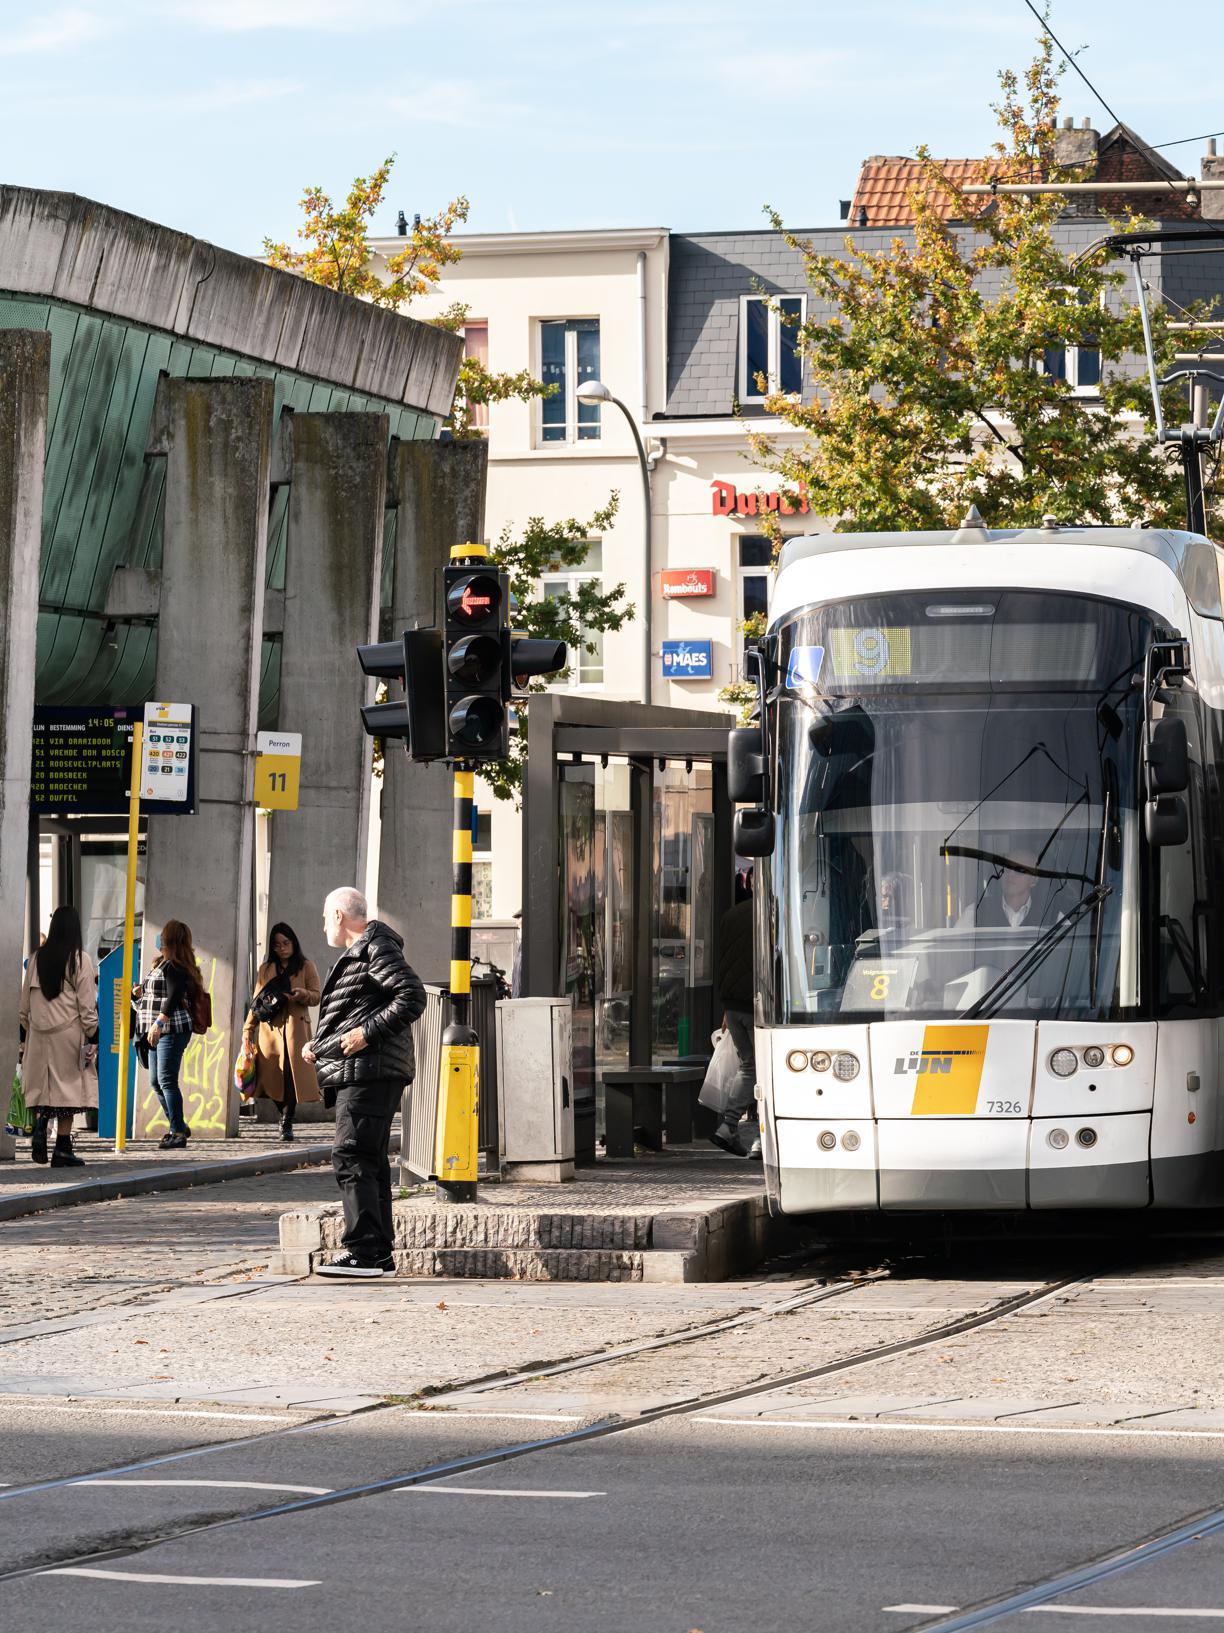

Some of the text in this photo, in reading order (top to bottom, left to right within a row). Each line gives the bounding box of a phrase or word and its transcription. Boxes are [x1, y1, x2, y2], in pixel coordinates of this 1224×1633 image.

[853, 629, 888, 676] 9
[672, 653, 707, 666] MAES
[88, 718, 114, 727] 14:05
[268, 739, 291, 749] Perron
[35, 749, 45, 757] 51
[101, 749, 126, 757] BOSCO
[268, 772, 287, 792] 11
[49, 794, 78, 802] DUFFEL
[870, 975, 890, 1000] 8
[986, 1100, 1022, 1114] 7326
